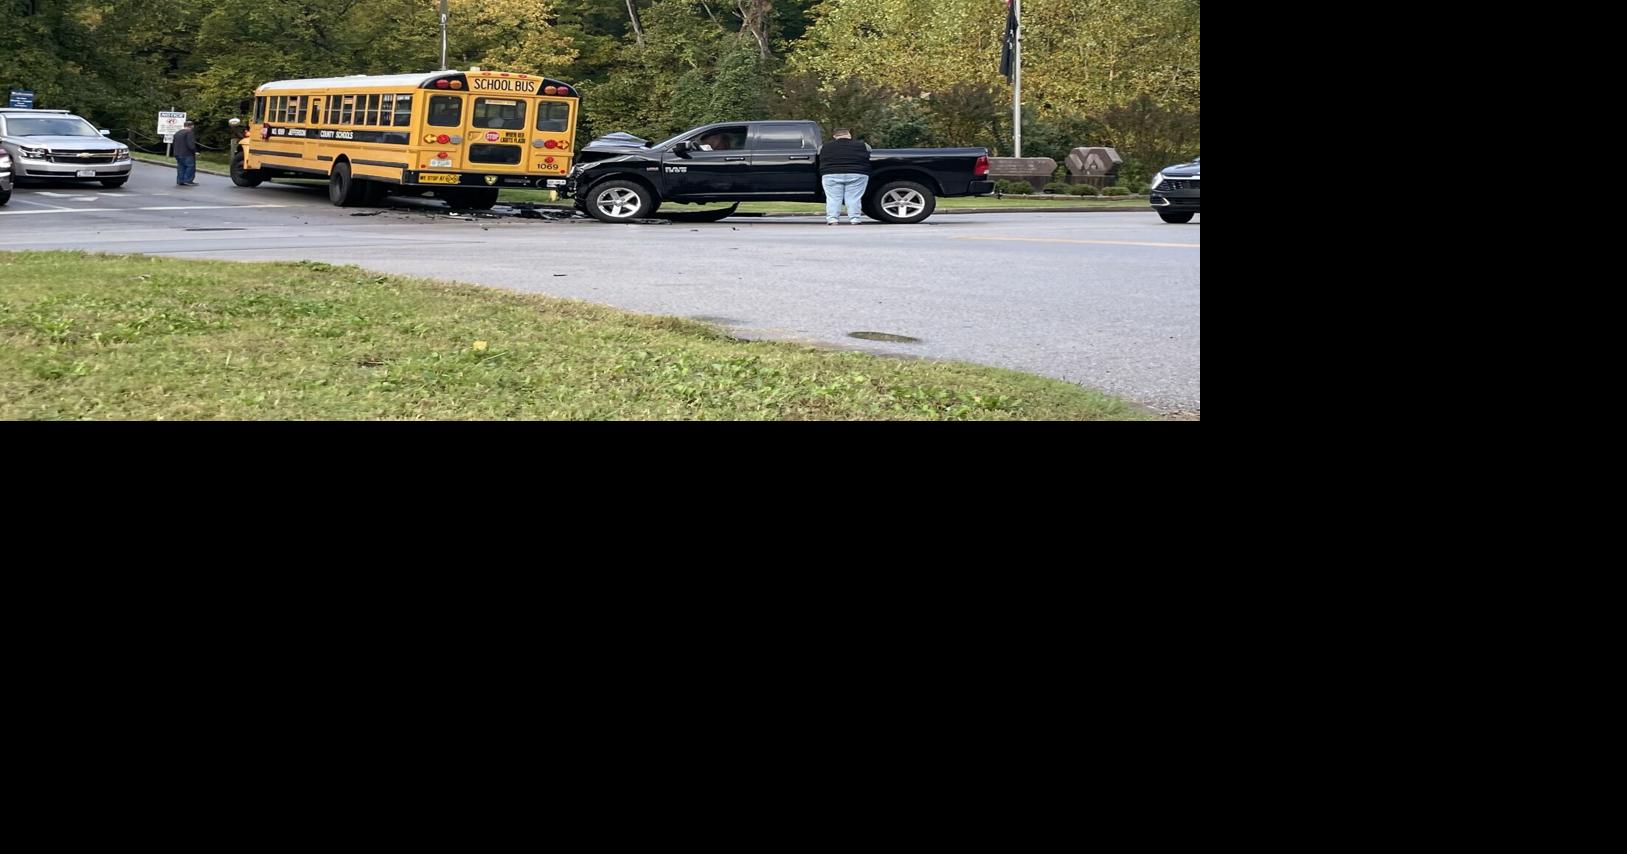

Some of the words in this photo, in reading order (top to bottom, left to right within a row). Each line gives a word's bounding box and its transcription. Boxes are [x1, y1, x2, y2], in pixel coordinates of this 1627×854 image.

[474, 78, 513, 91] SCHOOL
[515, 80, 535, 92] BUS
[320, 130, 335, 138] COUNTY
[335, 131, 354, 139] SCHOOLS
